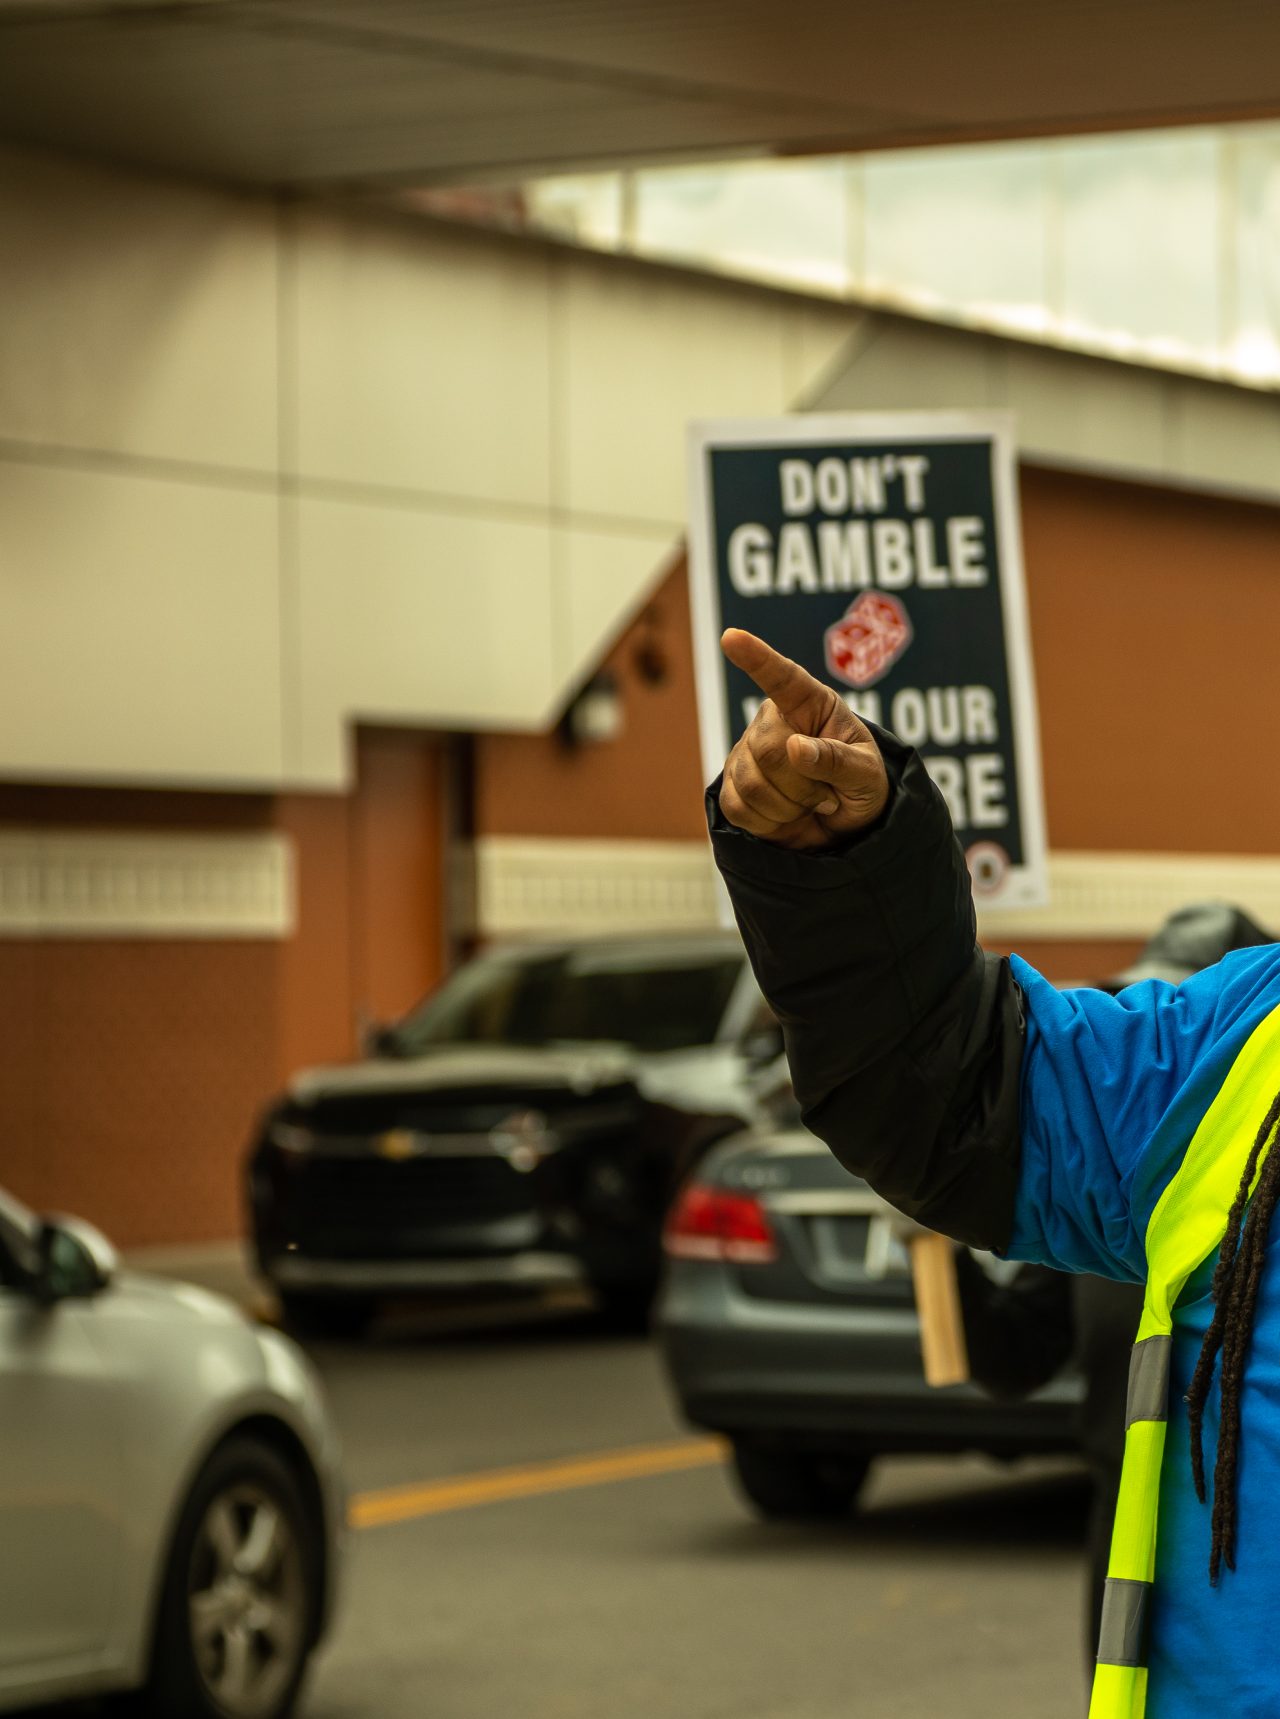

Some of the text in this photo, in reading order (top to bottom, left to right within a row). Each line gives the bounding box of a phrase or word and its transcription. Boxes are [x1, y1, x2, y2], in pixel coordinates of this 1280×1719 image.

[779, 454, 929, 515] DON'T
[727, 516, 988, 597] GAMBLE
[891, 684, 999, 748] OUR
